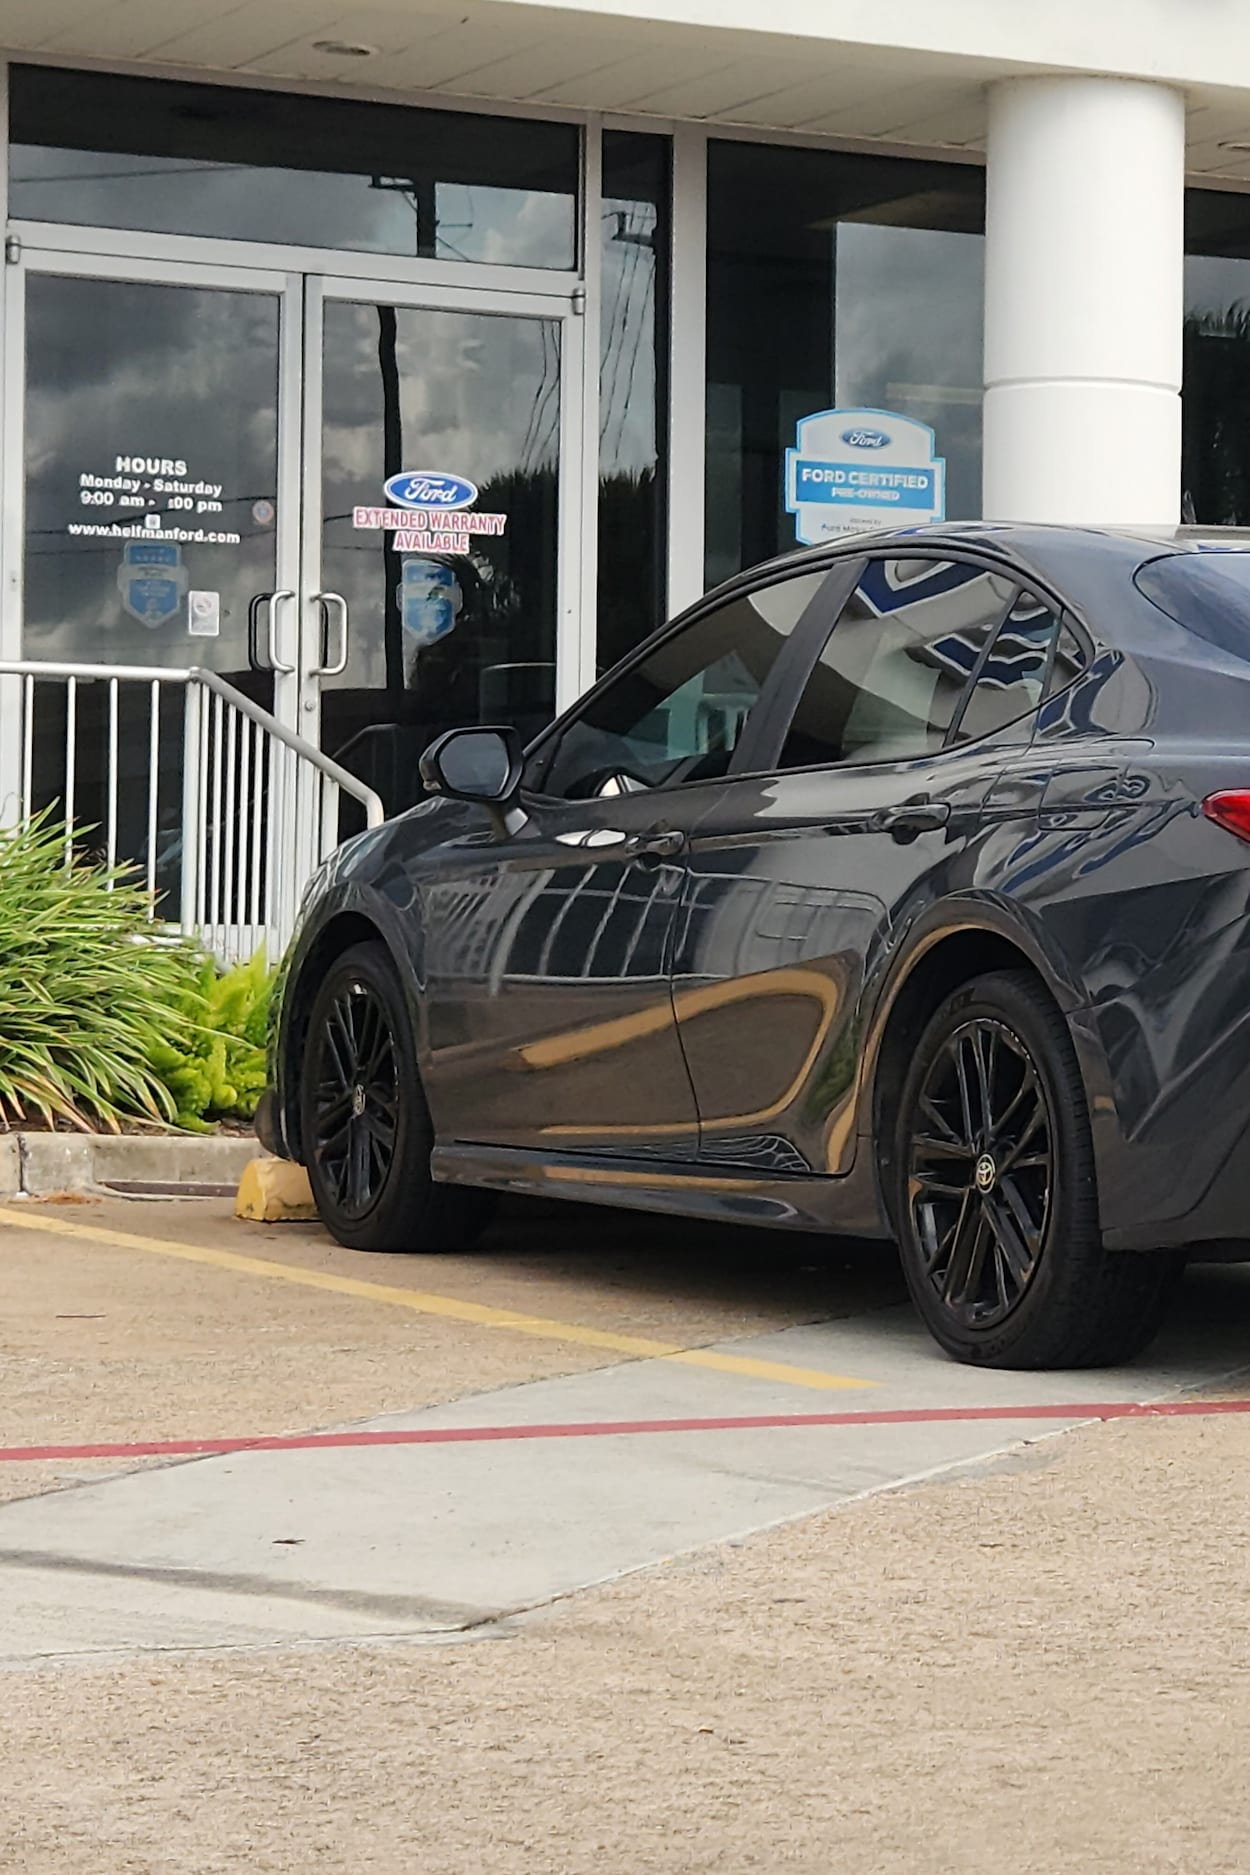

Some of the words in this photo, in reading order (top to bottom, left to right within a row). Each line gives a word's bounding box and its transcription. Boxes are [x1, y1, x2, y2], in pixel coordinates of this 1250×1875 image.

[850, 432, 883, 446] Ford
[115, 456, 187, 476] HOURS
[80, 473, 141, 492] Monday
[153, 479, 222, 498] Saturday
[404, 478, 458, 502] Ford
[802, 468, 846, 483] FORD
[848, 471, 929, 490] CERTIFIED
[80, 490, 114, 505] 9:00
[119, 495, 145, 507] am
[197, 501, 223, 513] pm
[355, 508, 427, 528] EXTENDED
[429, 511, 506, 535] WARRANTY
[68, 523, 241, 544] www.helfmanford.com
[396, 531, 469, 553] AVAILABLE
